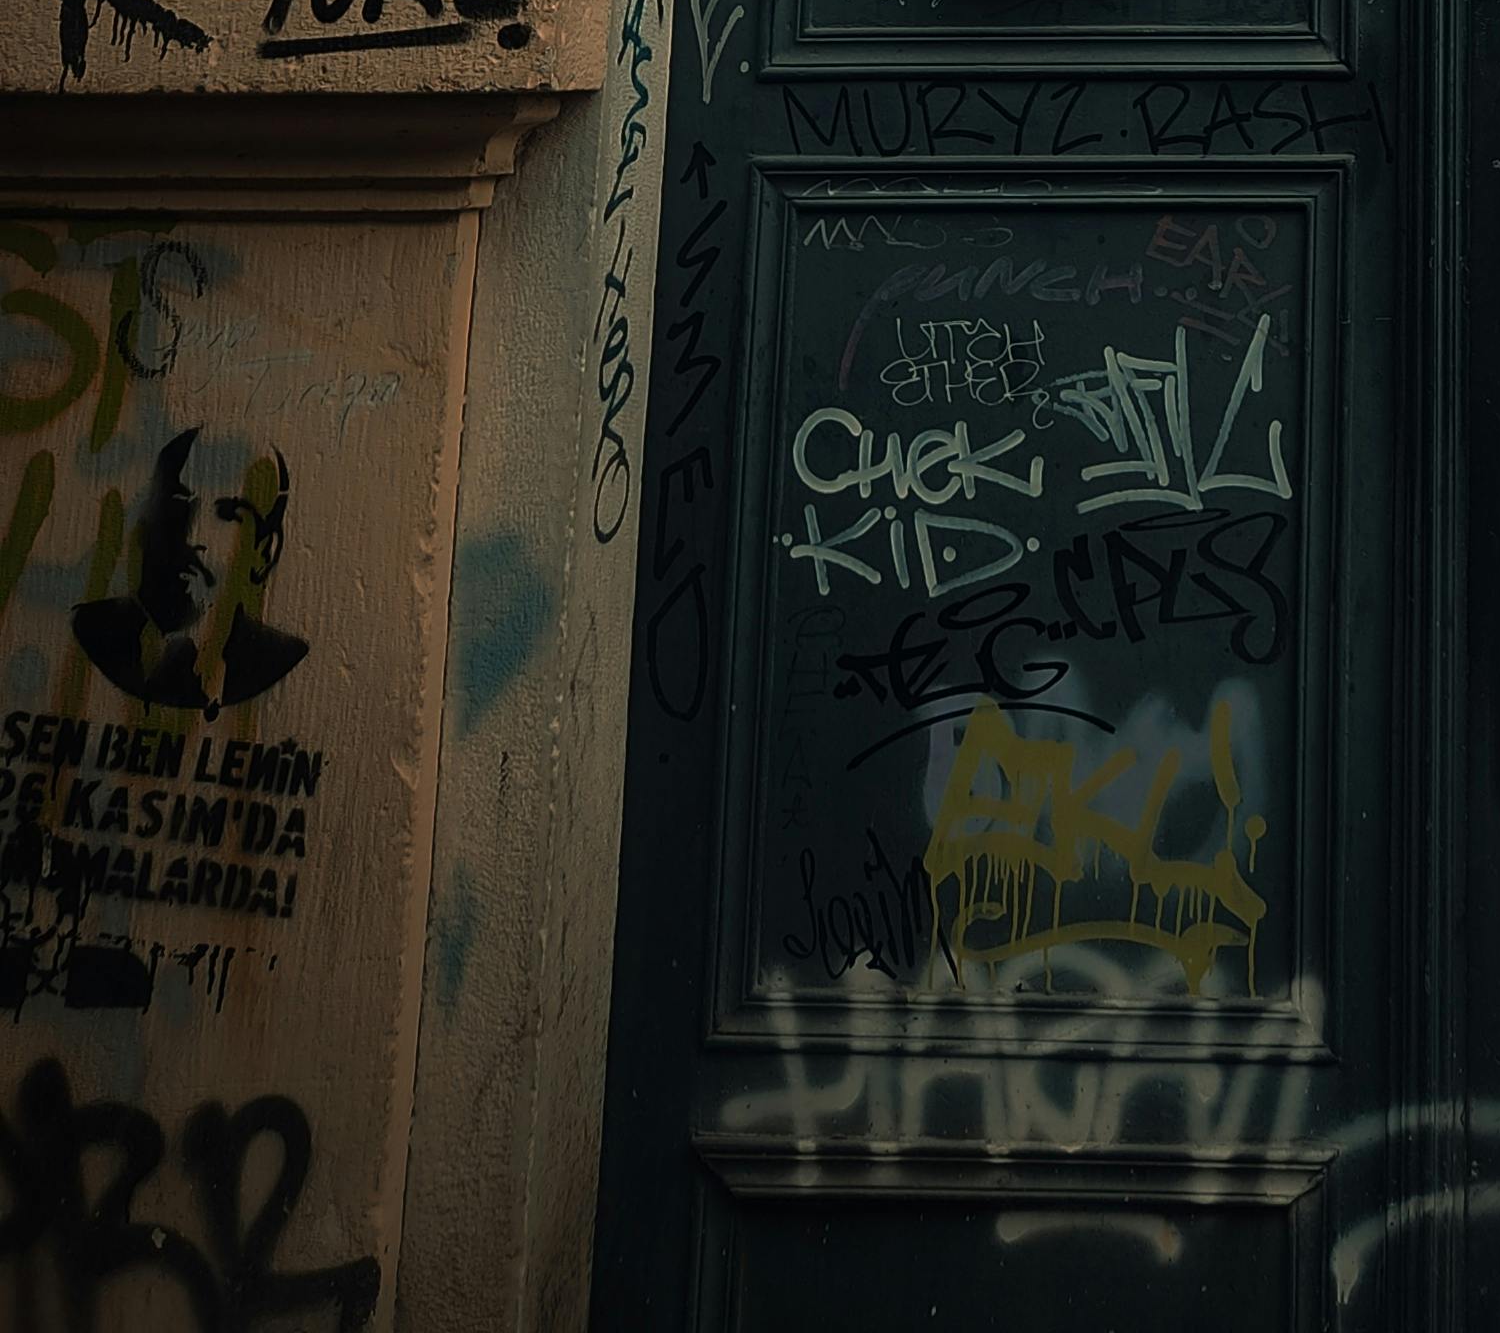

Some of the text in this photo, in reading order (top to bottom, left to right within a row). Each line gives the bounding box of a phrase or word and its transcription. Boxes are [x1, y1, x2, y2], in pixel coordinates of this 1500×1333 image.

[3, 710, 90, 767] SEN
[96, 723, 186, 778] BEN
[63, 778, 306, 857] KASIM'DA
